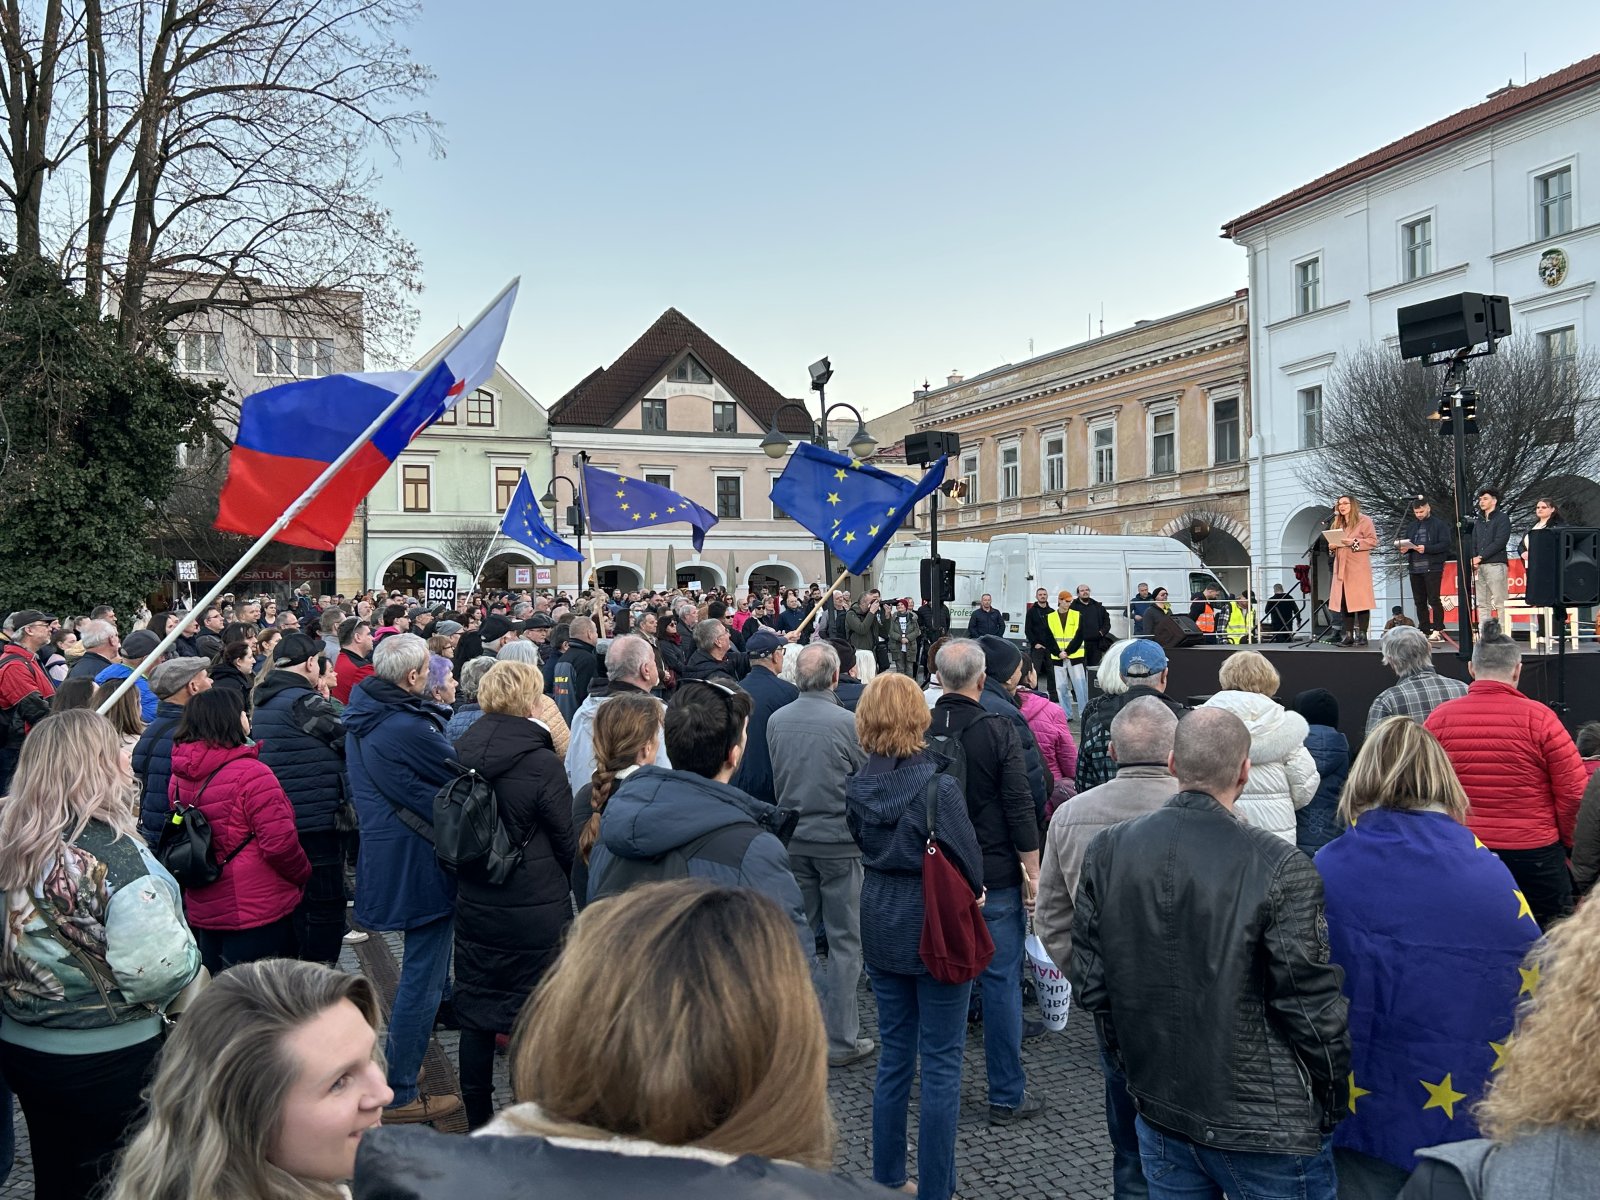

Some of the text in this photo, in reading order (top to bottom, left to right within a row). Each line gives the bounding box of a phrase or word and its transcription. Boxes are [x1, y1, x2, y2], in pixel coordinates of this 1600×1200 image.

[244, 571, 284, 579] SATUR
[429, 576, 455, 589] DOSŤ
[428, 589, 455, 600] BOLO
